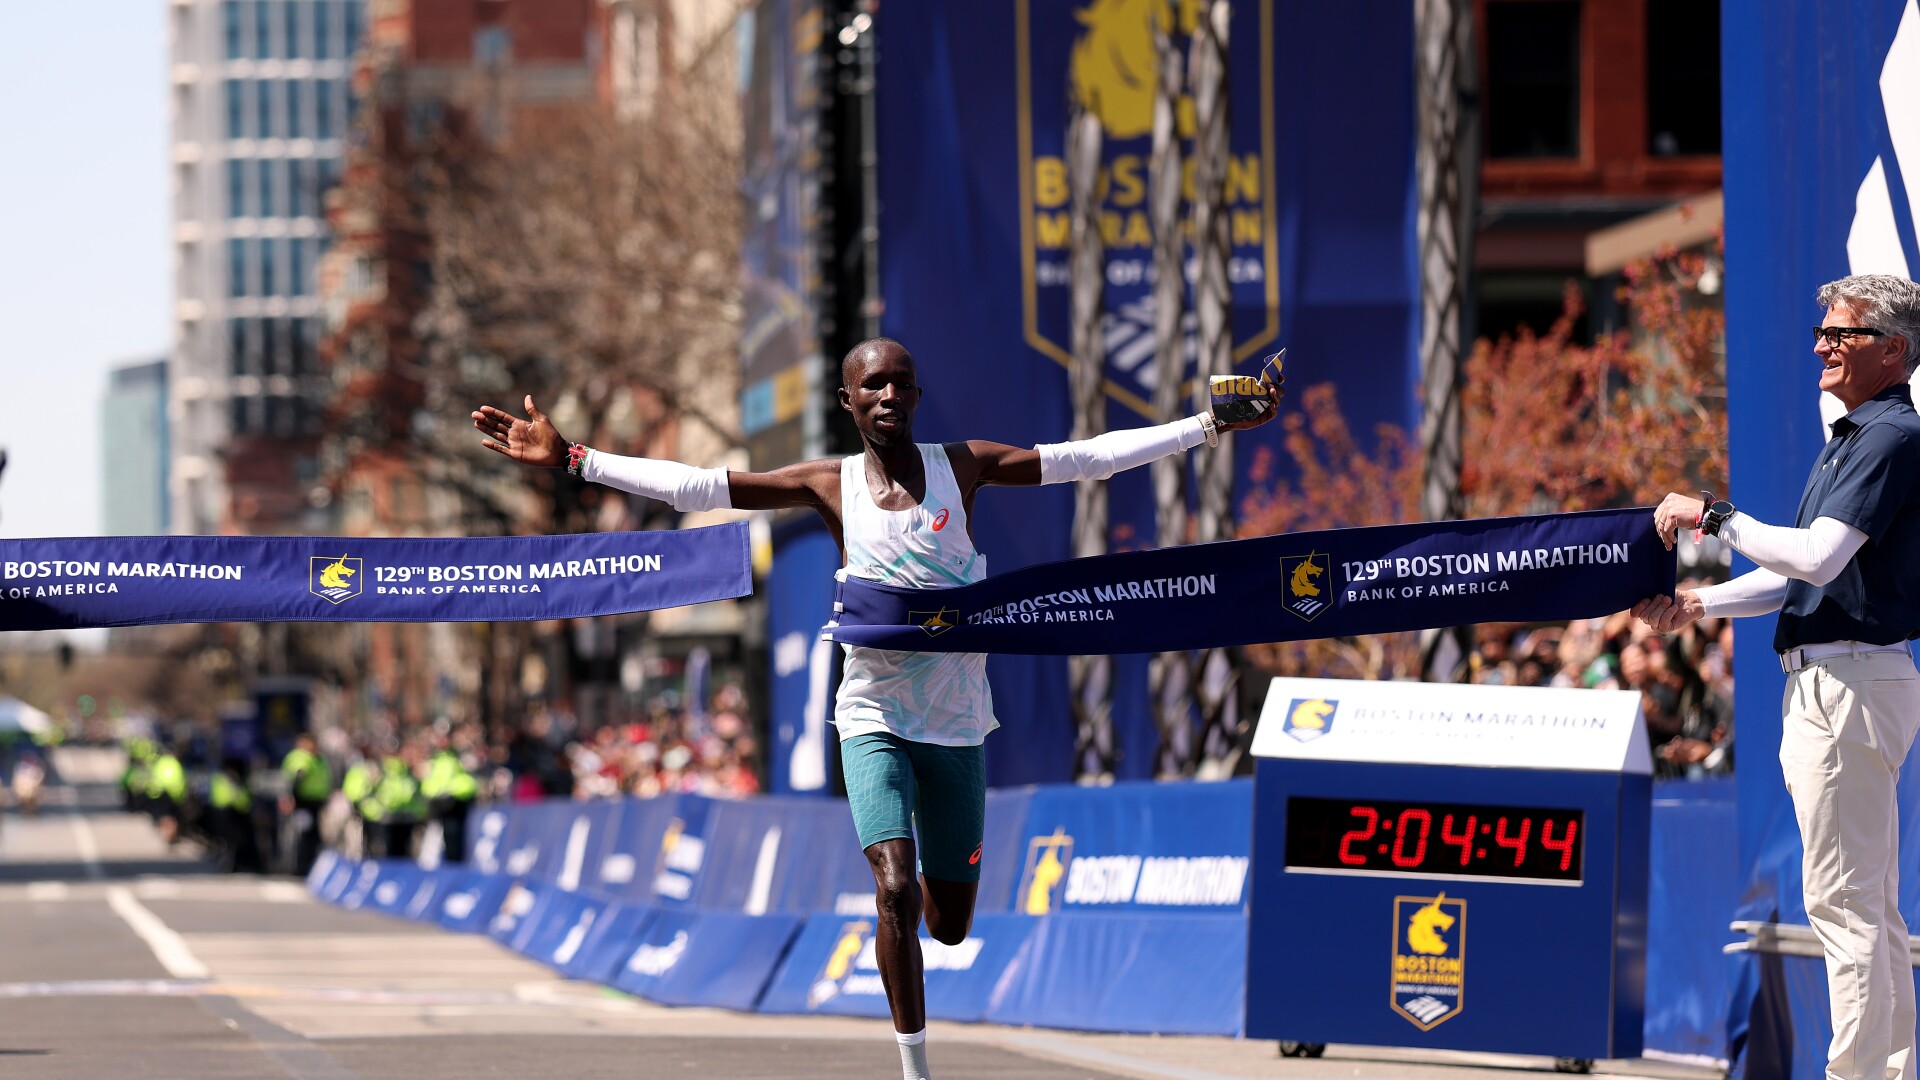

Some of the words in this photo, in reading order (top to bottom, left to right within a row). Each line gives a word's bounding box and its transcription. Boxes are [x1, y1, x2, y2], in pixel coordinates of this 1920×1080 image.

[4, 560, 100, 579] BOSTON
[107, 562, 242, 580] MARATHON
[374, 566, 425, 582] 129TH
[428, 564, 522, 582] BOSTON
[529, 554, 661, 579] MARATHON
[1342, 558, 1392, 582] 129TH
[1396, 552, 1490, 578] BOSTON
[1496, 543, 1629, 572] MARATHON
[9, 587, 31, 599] OF
[35, 582, 119, 598] AMERICA
[377, 586, 427, 595] BANK
[431, 585, 454, 594] OF
[458, 584, 541, 593] AMERICA
[1093, 574, 1216, 603] MARATHON
[1347, 587, 1396, 602] BANK
[1401, 585, 1424, 598] OF
[1428, 580, 1510, 597] AMERICA
[1020, 612, 1040, 623] OF
[1044, 609, 1115, 622] AMERICA
[1354, 707, 1454, 722] BOSTON
[1464, 711, 1608, 730] MARATHON
[1338, 806, 1578, 871] 2:04:44
[1396, 954, 1460, 974] BOSTON
